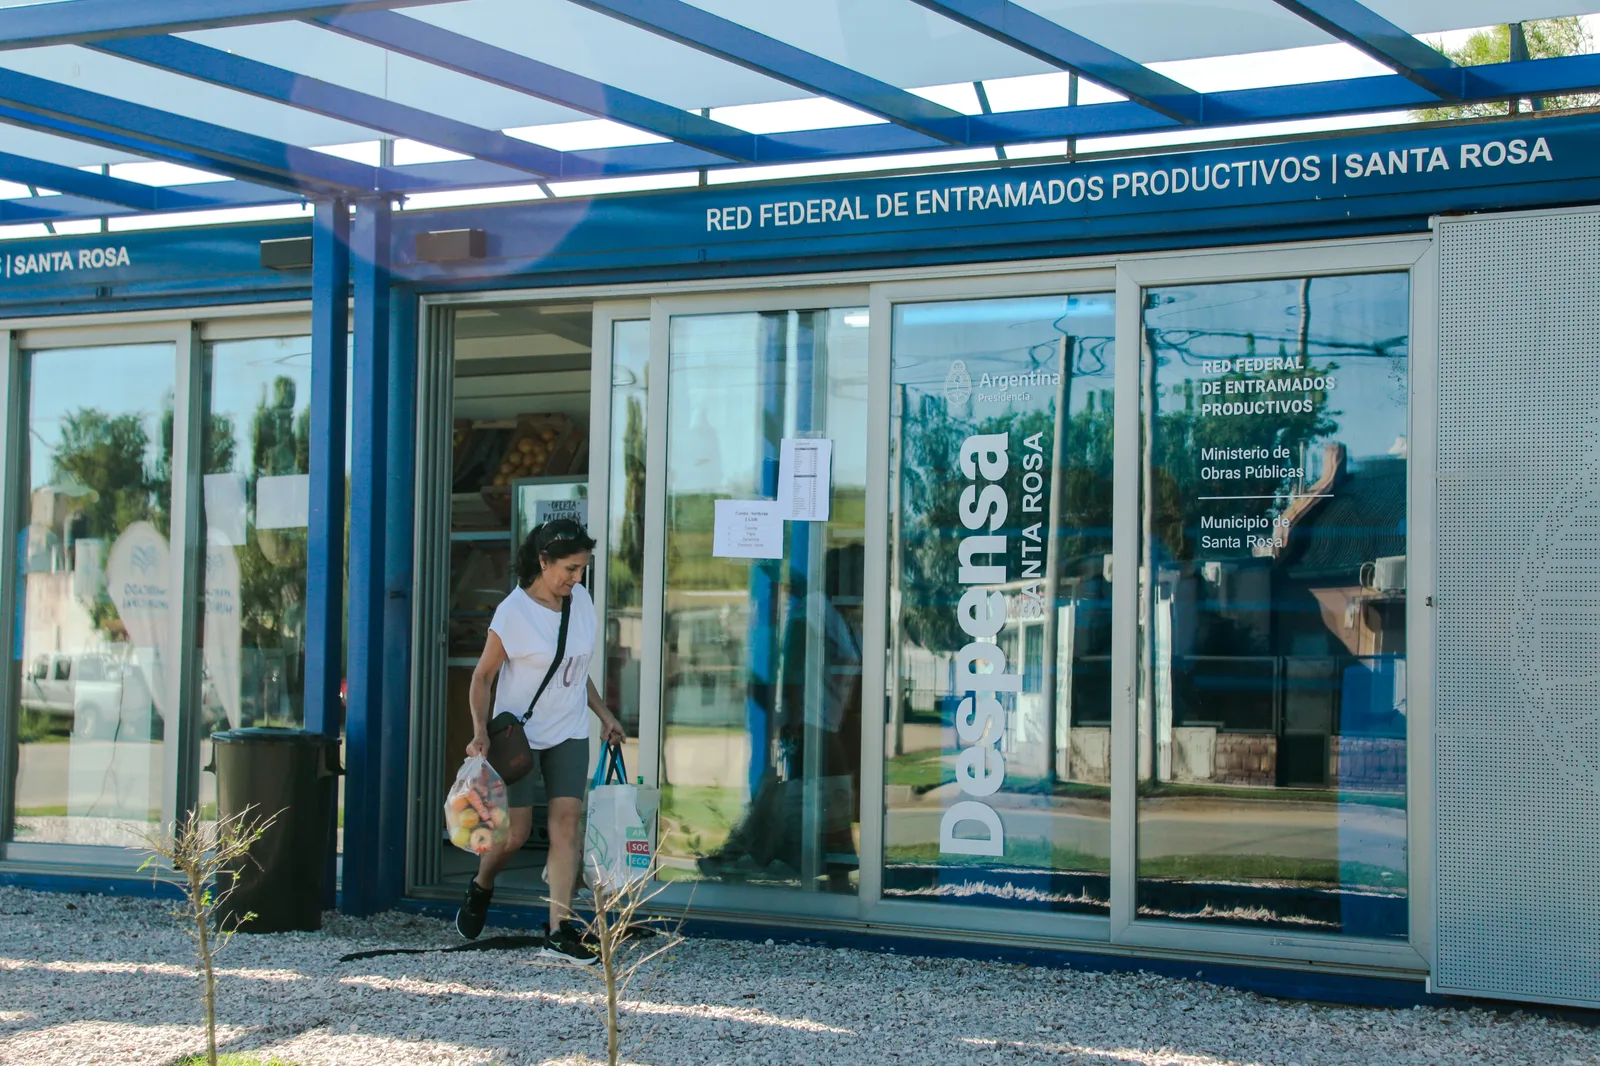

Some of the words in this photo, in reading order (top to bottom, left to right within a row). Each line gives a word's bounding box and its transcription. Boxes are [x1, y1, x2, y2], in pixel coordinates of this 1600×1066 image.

[706, 206, 752, 232] RED
[759, 196, 869, 228] FEDERAL
[876, 192, 909, 219] DE
[916, 175, 1104, 215] ENTRAMADOS
[1112, 155, 1321, 199] PRODUCTIVOS
[1344, 146, 1450, 178] SANTA
[1459, 137, 1553, 169] ROSA
[14, 251, 74, 276] SANTA
[79, 246, 131, 269] ROSA
[1202, 359, 1232, 374] RED
[1236, 356, 1304, 373] FEDERAL
[980, 369, 1061, 392] Argentina
[1202, 381, 1221, 395] DE
[1225, 376, 1336, 394] ENTRAMADOS
[978, 392, 1030, 402] Presidencia
[1202, 399, 1313, 416] PRODUCTIVOS
[1201, 447, 1269, 460] Ministerio
[1272, 445, 1290, 459] de
[1022, 431, 1043, 512] ROSA
[1201, 467, 1241, 480] Obras
[1245, 464, 1304, 479] Públicas
[1201, 515, 1269, 531] Municipio
[1272, 515, 1290, 528] de
[1201, 536, 1241, 548] Santa
[1246, 535, 1283, 548] Rosa
[1021, 521, 1042, 618] SANTA
[939, 432, 1023, 857] Despensa
[632, 844, 648, 852] SOC
